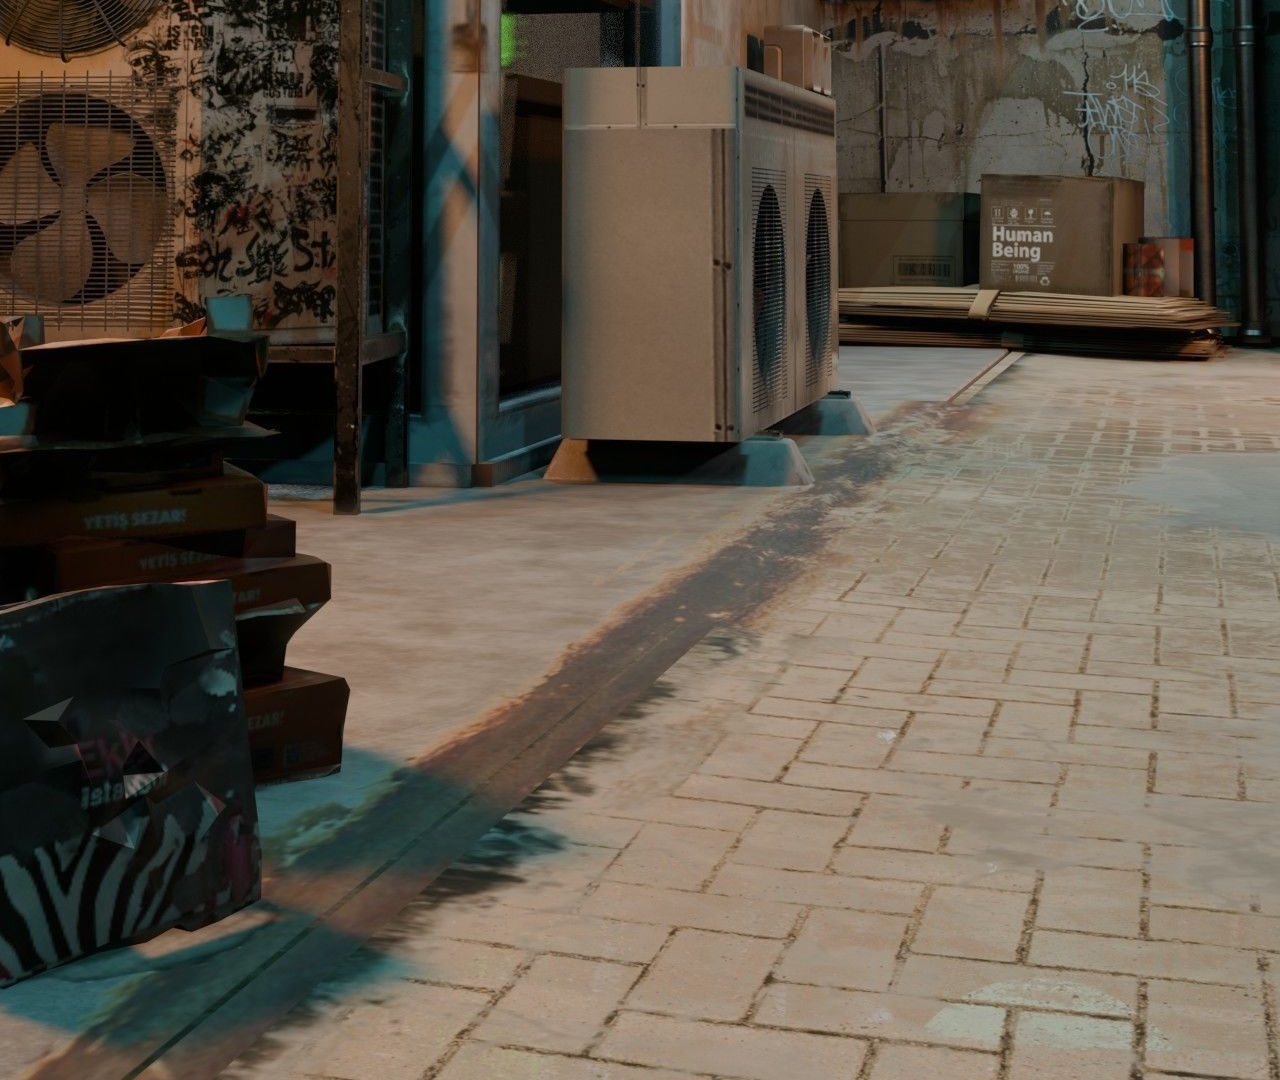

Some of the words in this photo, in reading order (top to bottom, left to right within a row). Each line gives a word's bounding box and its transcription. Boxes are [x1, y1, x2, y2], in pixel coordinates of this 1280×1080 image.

[992, 226, 1054, 243] Human
[992, 242, 1041, 263] Being
[248, 709, 286, 731] EZAR!
